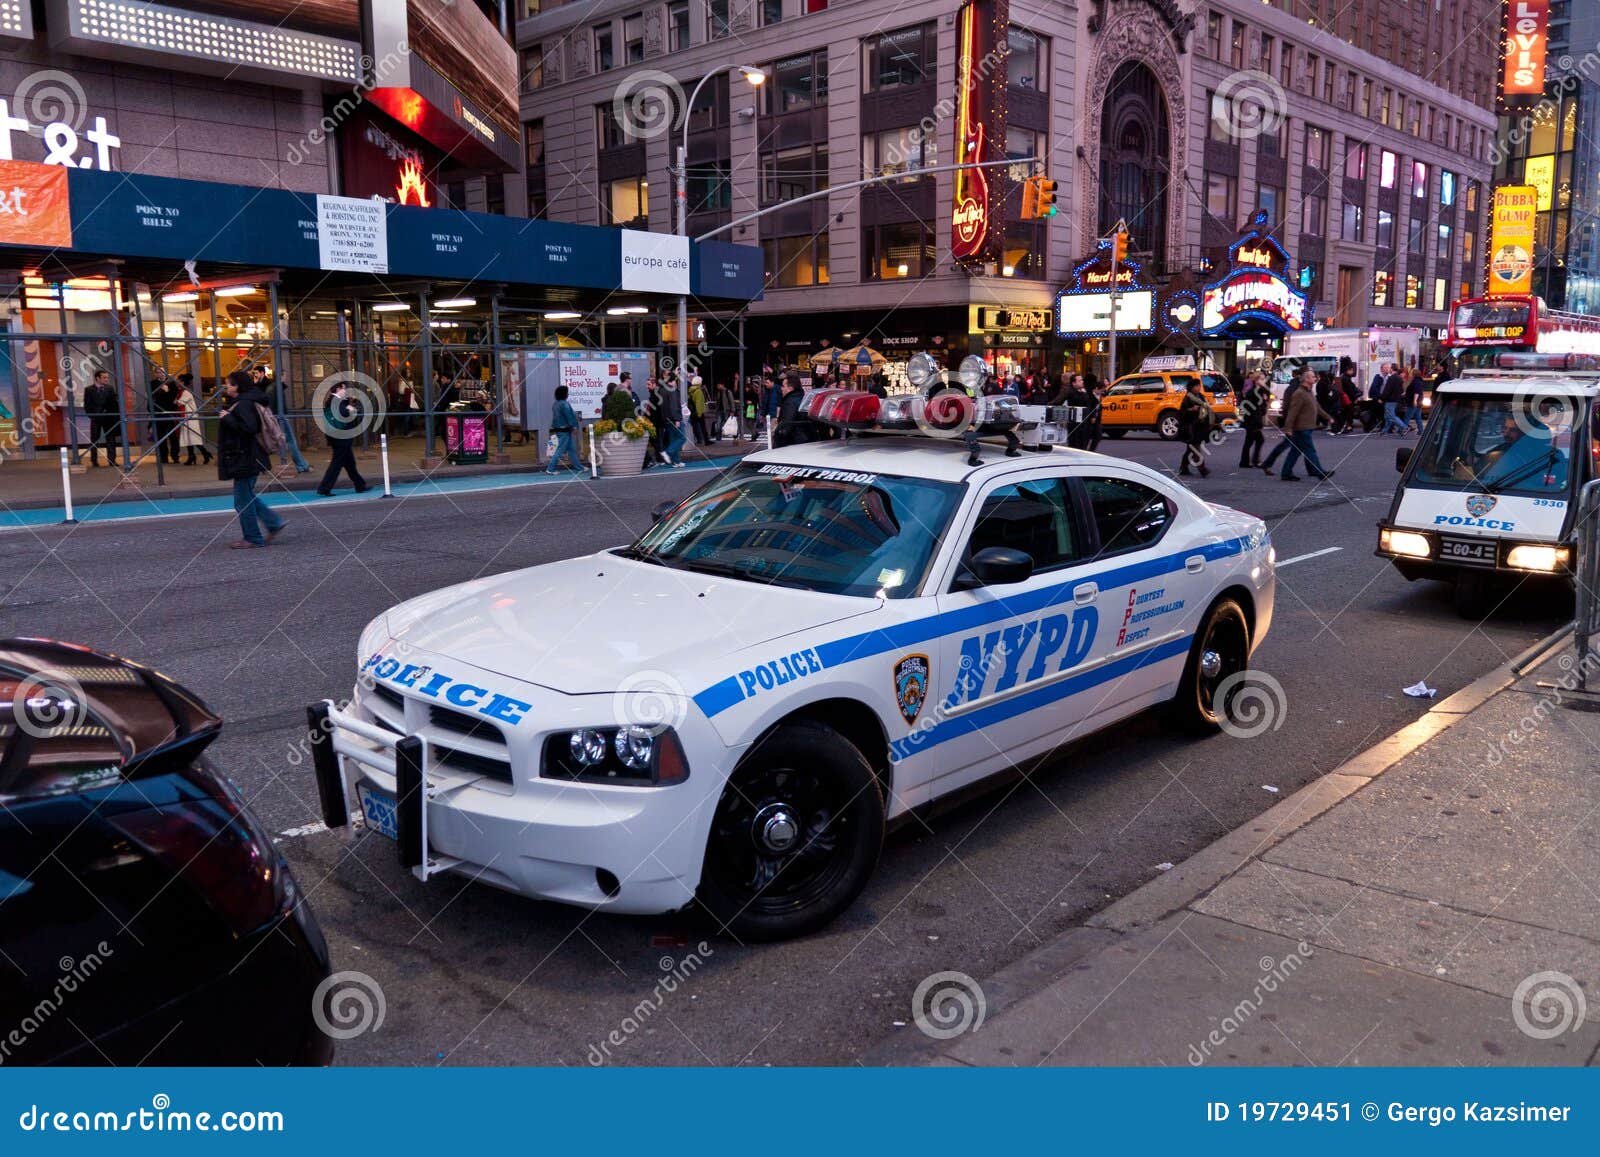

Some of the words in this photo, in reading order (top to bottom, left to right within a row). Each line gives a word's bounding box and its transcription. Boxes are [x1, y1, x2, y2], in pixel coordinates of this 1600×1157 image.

[1496, 192, 1535, 206] BUBBA
[135, 204, 162, 216] POST
[164, 207, 180, 217] NO
[1498, 210, 1531, 222] GUMP
[142, 217, 173, 228] BILLS
[431, 233, 450, 242] POST
[452, 235, 463, 244] NO
[435, 244, 458, 253] BILLS
[544, 244, 561, 253] POST
[563, 246, 572, 254] NO
[548, 254, 568, 262] BILLS
[624, 255, 663, 269] europa
[666, 257, 688, 270] café
[1087, 271, 1110, 283] Hard
[1110, 270, 1132, 283] ock
[1476, 327, 1499, 338] NIGHT
[1502, 326, 1524, 338] LOOP
[900, 336, 919, 345] SHOP
[564, 366, 587, 376] Hello
[565, 378, 584, 388] New
[584, 377, 603, 388] York
[757, 464, 816, 478] HIGHWAY
[816, 470, 879, 484] PATROL
[1533, 499, 1564, 509] 3930
[1433, 515, 1515, 532] POLICE
[1453, 543, 1483, 558] GO-4
[948, 605, 1100, 706] NYPD
[902, 657, 921, 667] POLICE
[739, 646, 820, 698] POLICE
[361, 653, 533, 726] POLICE
